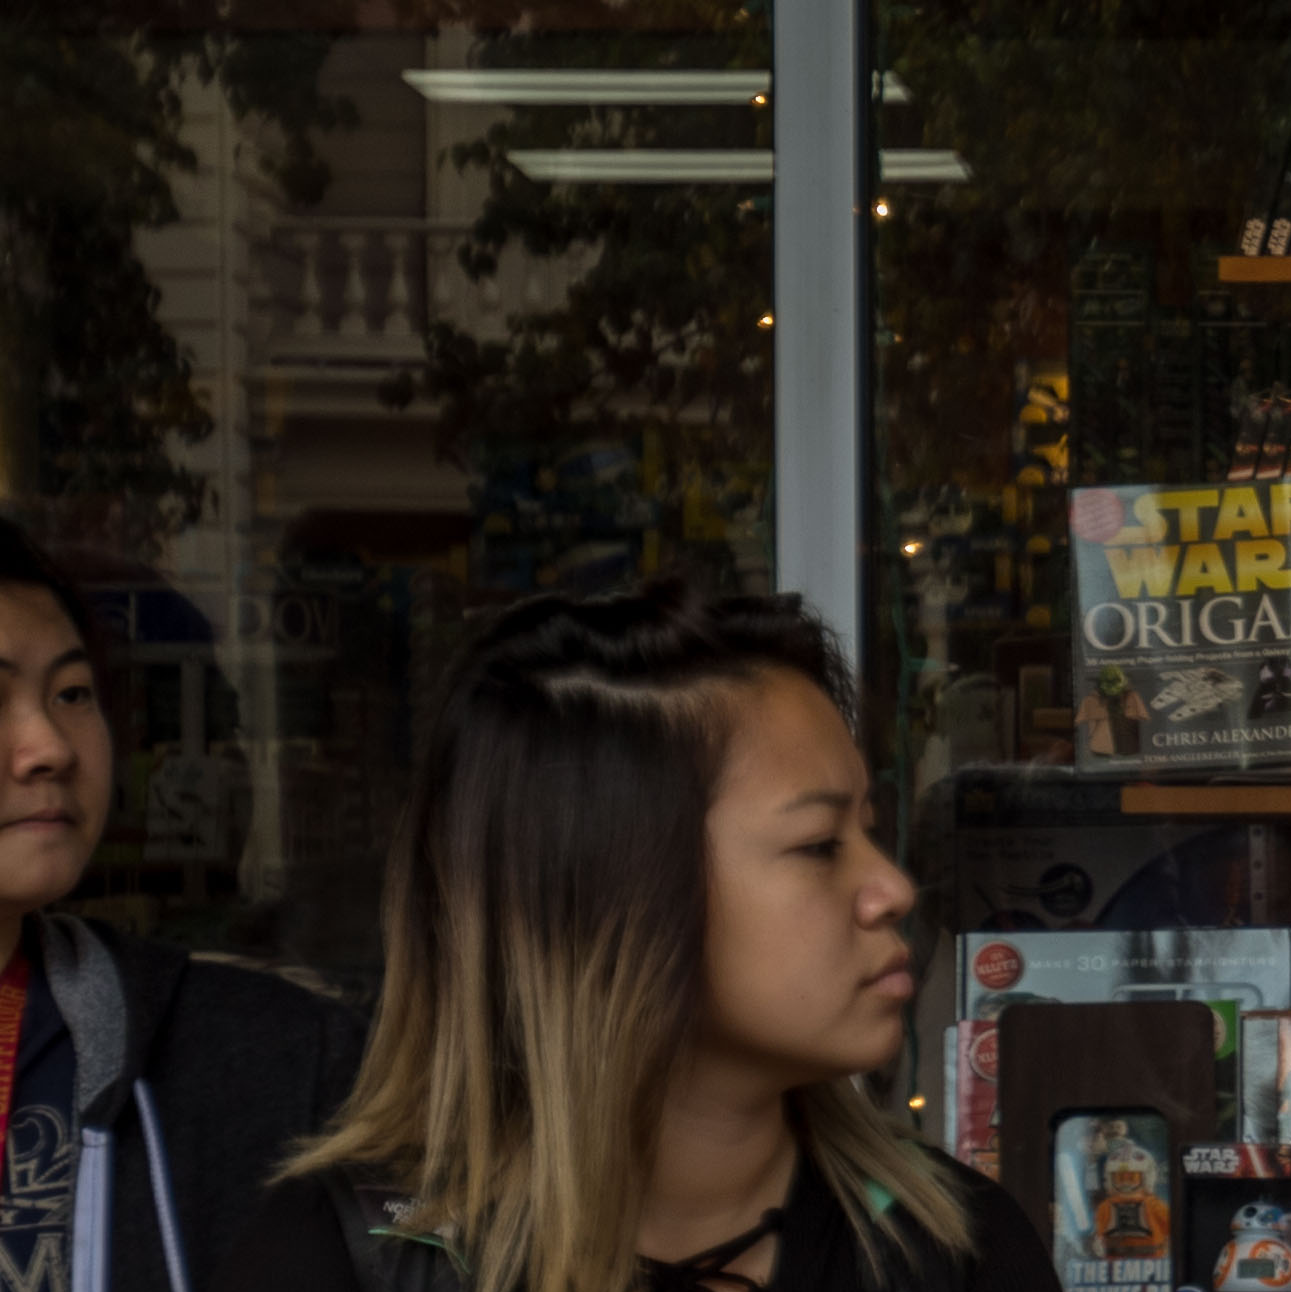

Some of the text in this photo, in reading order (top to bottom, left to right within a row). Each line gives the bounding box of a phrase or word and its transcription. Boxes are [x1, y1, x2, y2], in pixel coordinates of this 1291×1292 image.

[1153, 731, 1207, 749] CHRIS
[975, 960, 1019, 977] KLUTZ
[1076, 956, 1105, 971] 30
[0, 984, 26, 1115] YFFINDOR
[1183, 1147, 1240, 1161] STAR
[1183, 1159, 1240, 1175] WARS
[1070, 1259, 1110, 1284] THE
